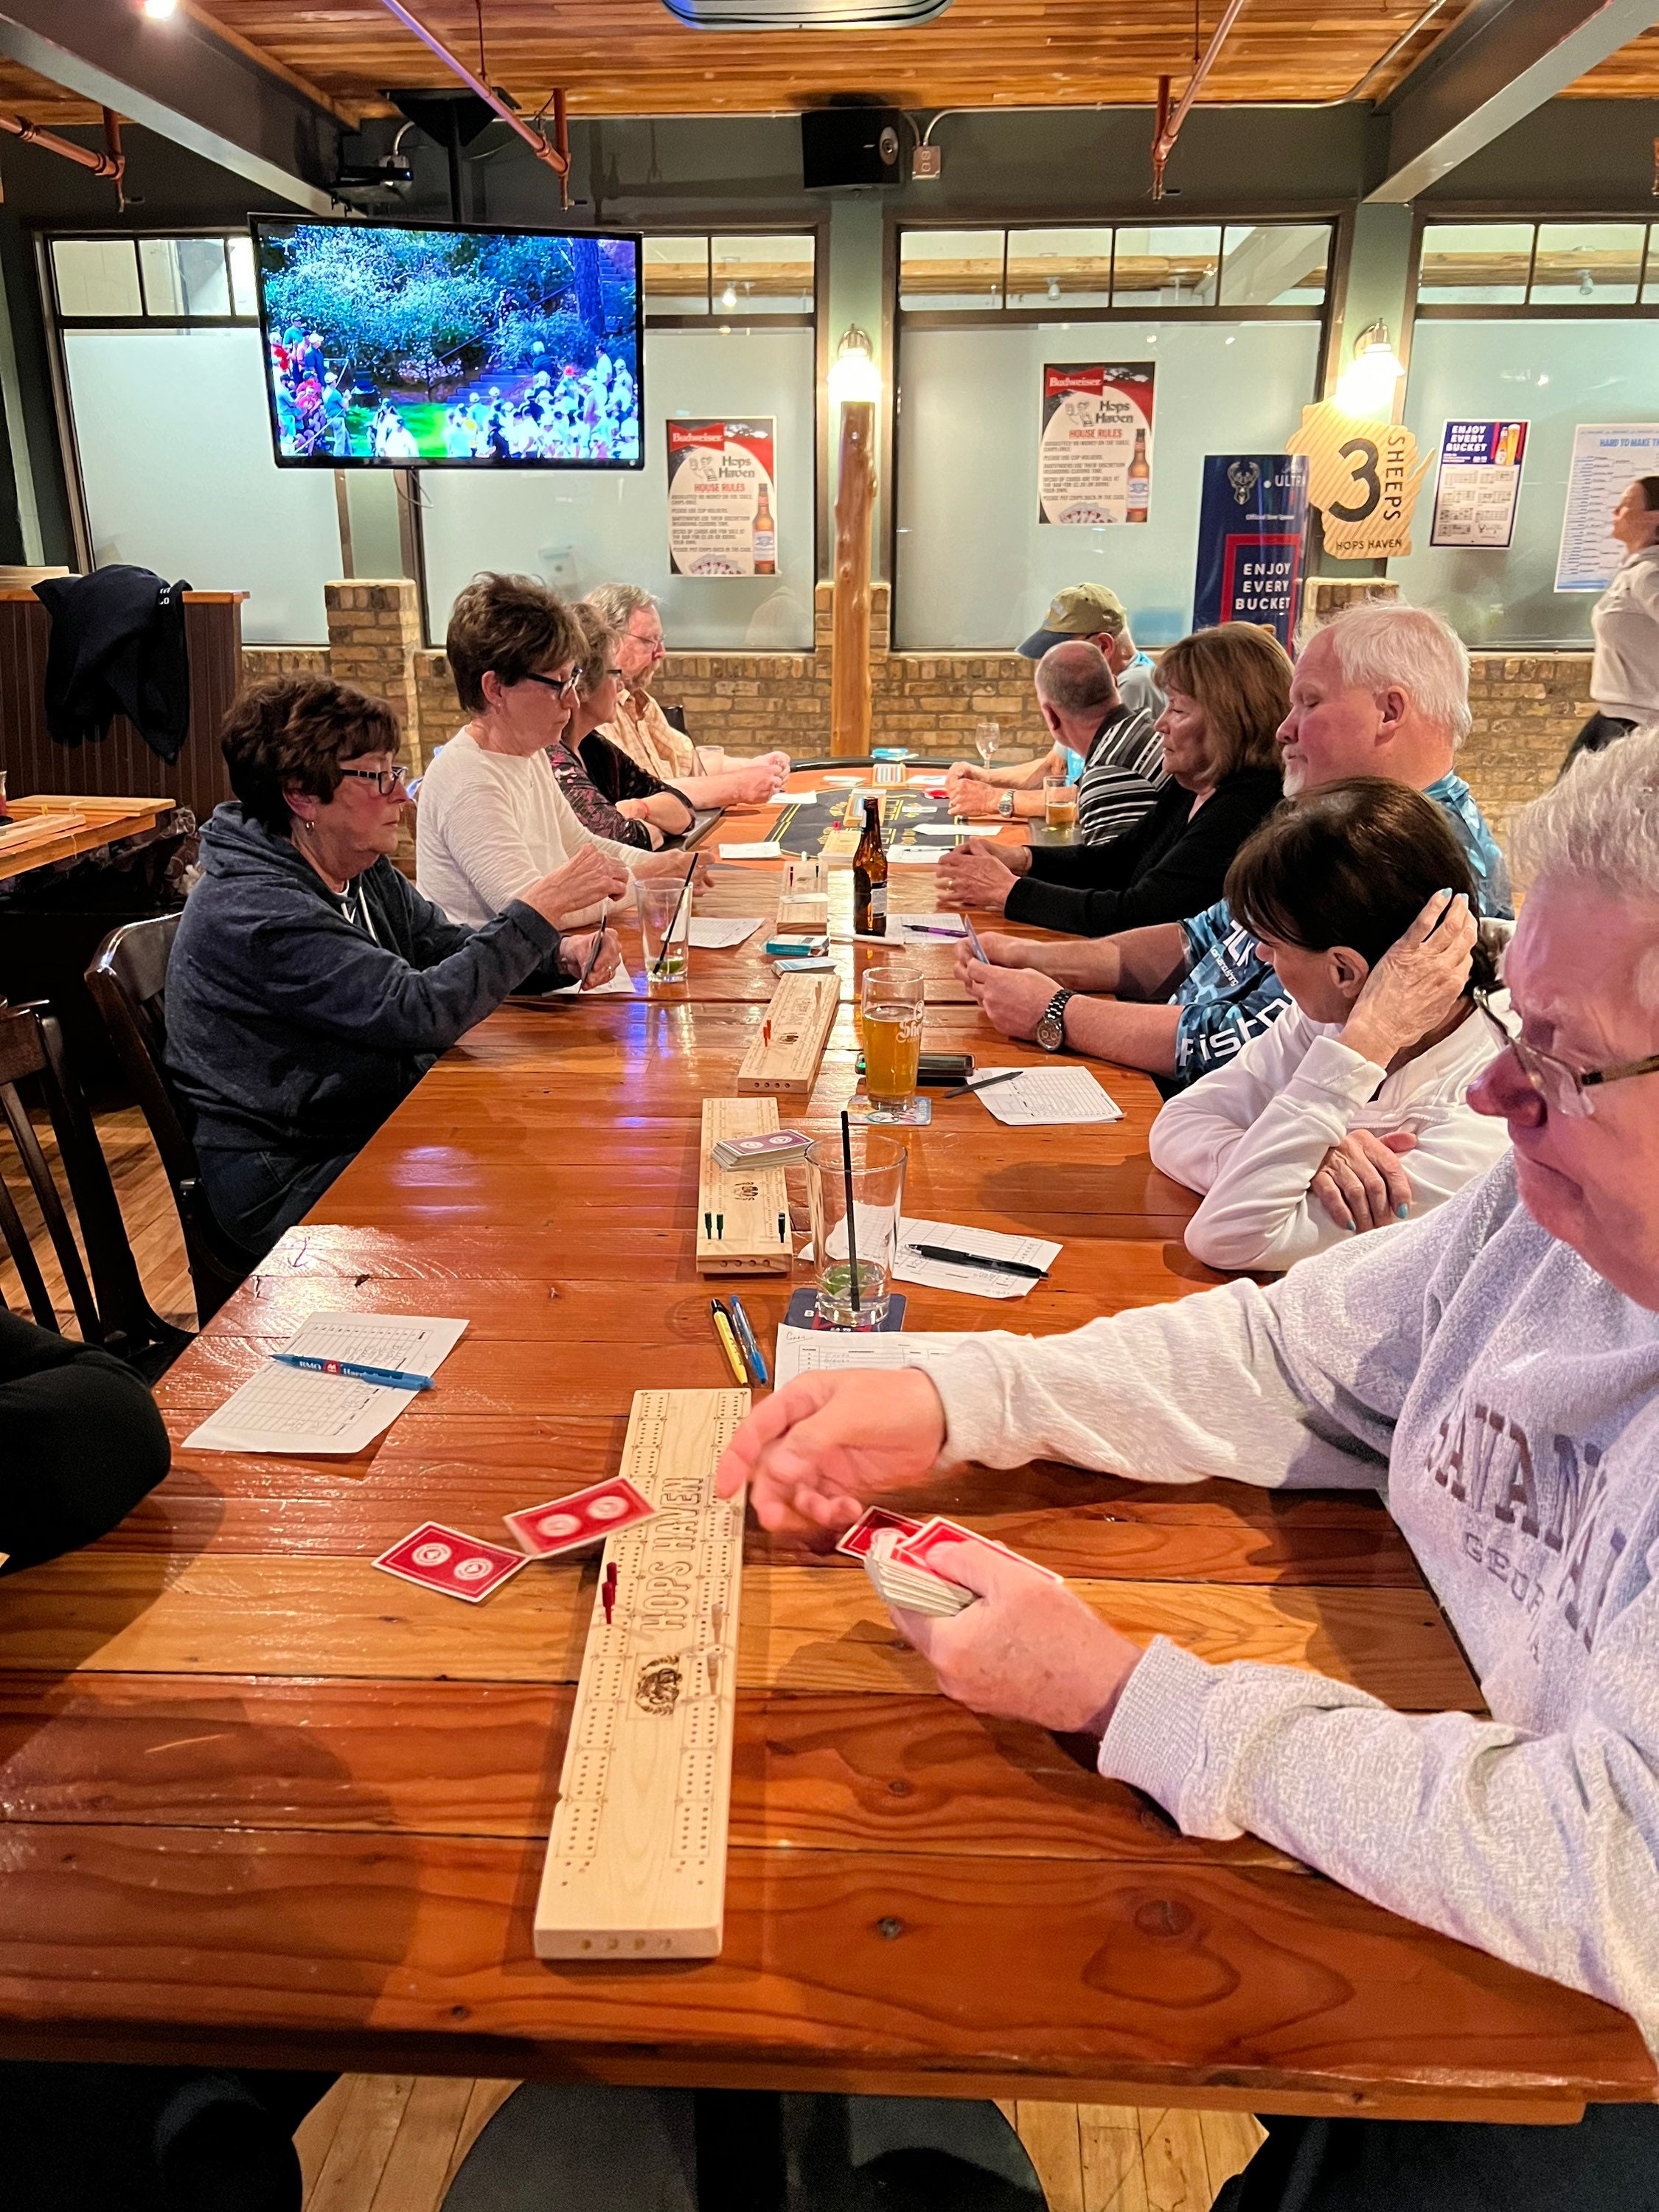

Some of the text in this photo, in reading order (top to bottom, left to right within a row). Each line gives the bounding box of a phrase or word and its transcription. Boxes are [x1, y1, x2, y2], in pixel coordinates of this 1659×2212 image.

[1049, 376, 1102, 387] Budweiser
[1099, 400, 1130, 413] Hops
[1096, 412, 1133, 423] Haven
[1451, 425, 1486, 434] ENJOY
[672, 432, 723, 442] Budweiser
[1450, 434, 1485, 442] EVERY
[1445, 442, 1488, 452] BUCKET
[723, 456, 751, 468] Hops
[719, 468, 756, 479] Haven
[1383, 435, 1405, 521] SHEEPS
[1329, 437, 1381, 523] 3
[1335, 539, 1402, 550] HOPS HAVEN
[1243, 563, 1291, 576] ENJOY
[1242, 580, 1289, 593] EVERY
[1235, 597, 1291, 610] BUCKET
[653, 1477, 703, 1553] HAVEN
[640, 1561, 692, 1632] HOPS
